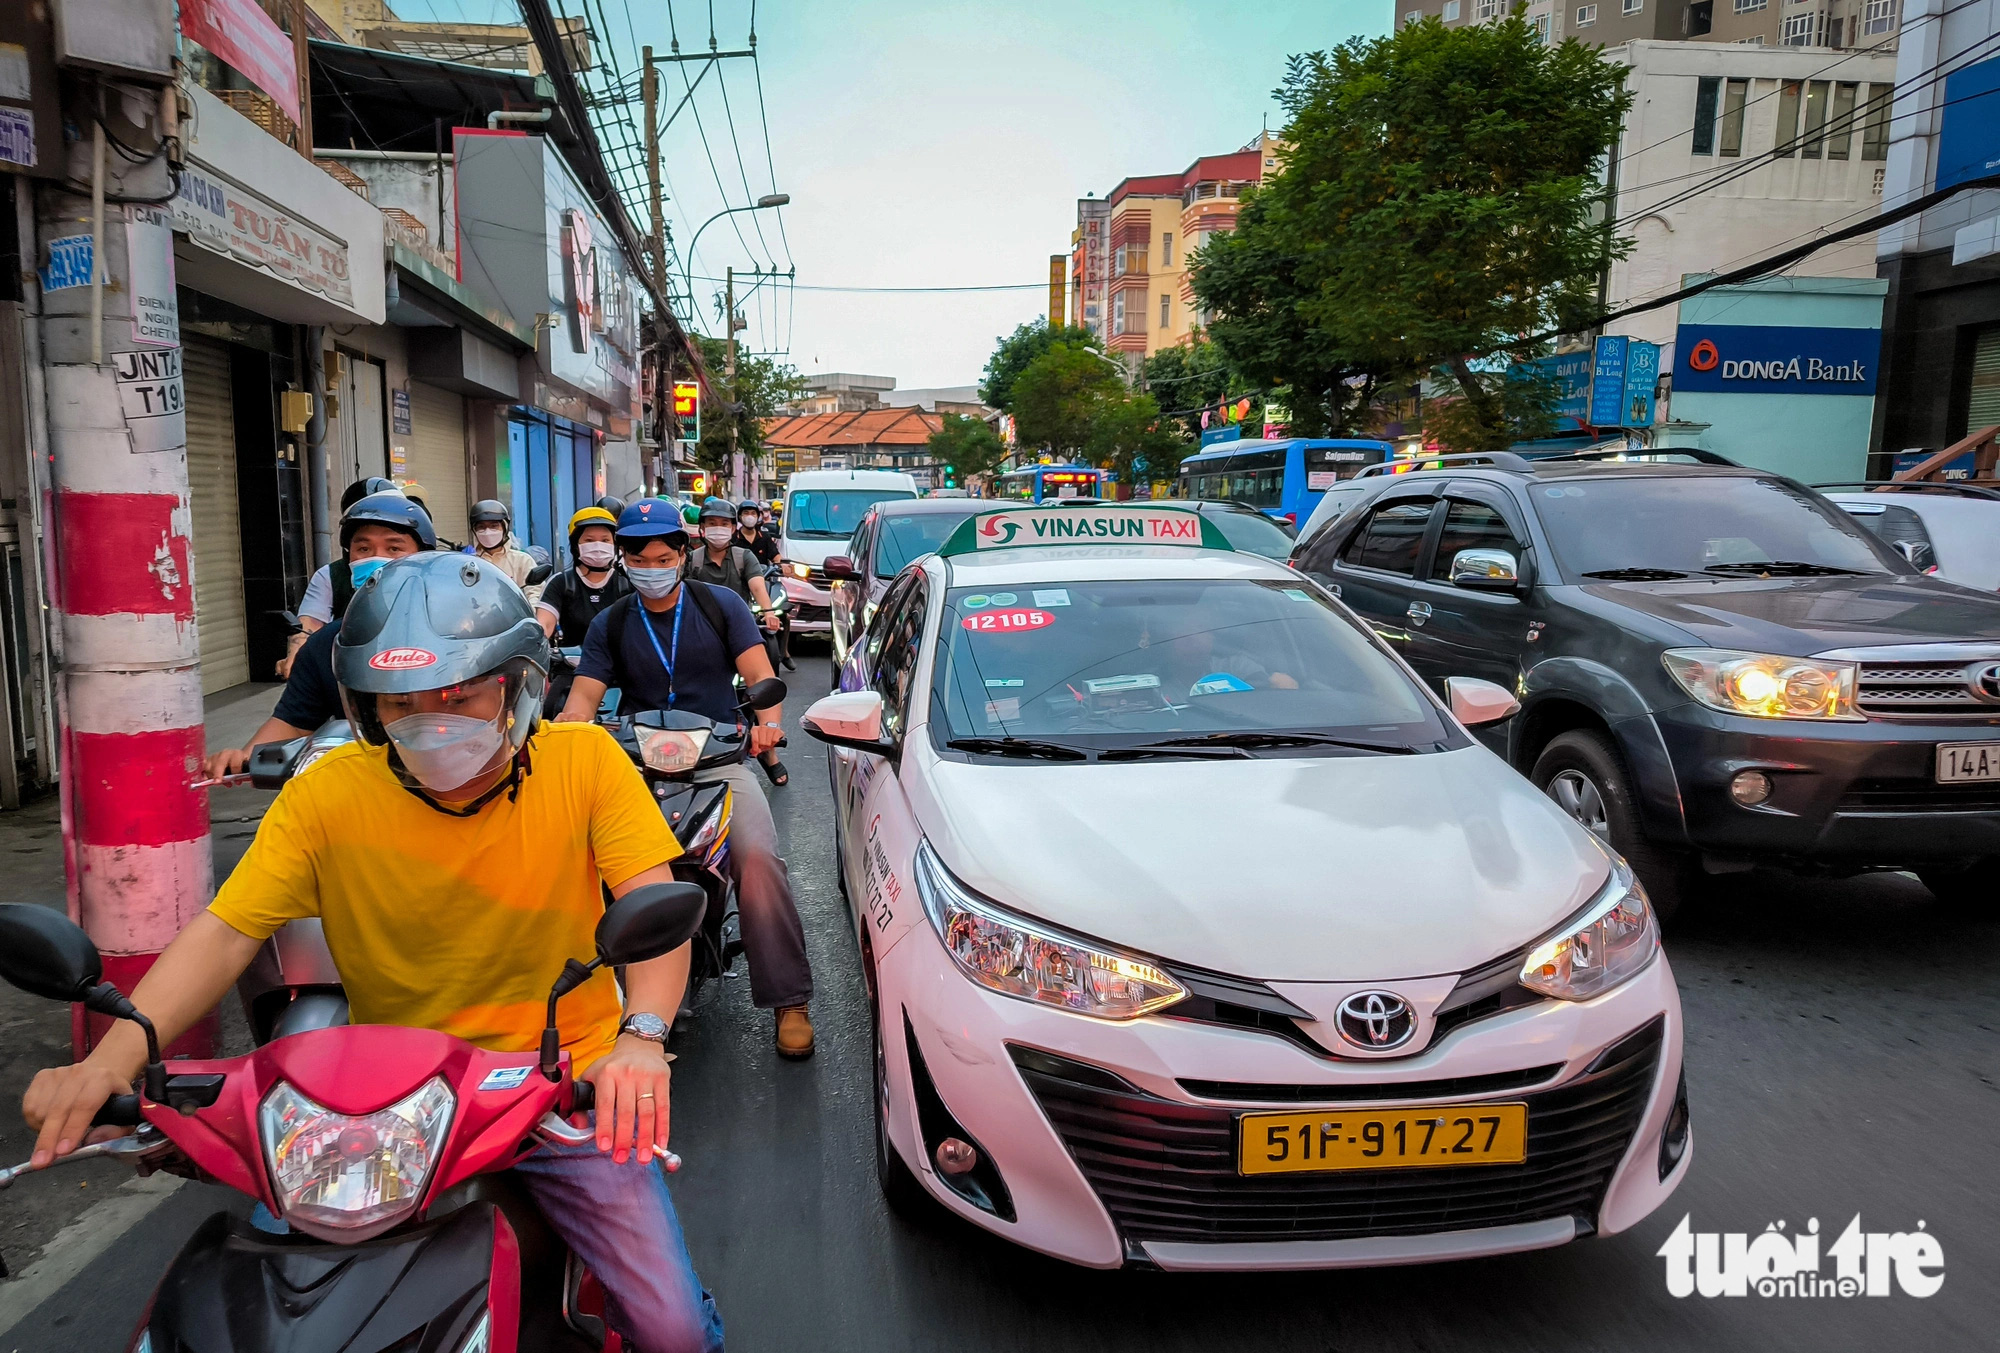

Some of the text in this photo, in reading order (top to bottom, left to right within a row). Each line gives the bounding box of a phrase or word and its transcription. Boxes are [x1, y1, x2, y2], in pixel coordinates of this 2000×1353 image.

[1088, 221, 1098, 300] HOTEL
[1806, 358, 1866, 382] Bank
[1325, 451, 1365, 462] SaigonBus
[1031, 518, 1197, 538] VINASUN TAXI
[968, 612, 1044, 630] 12105
[376, 650, 432, 664] Andes
[1948, 749, 2000, 778] 14A-
[885, 872, 902, 903] TAXI
[870, 886, 882, 914] 27
[876, 904, 893, 933] 27
[1267, 1116, 1501, 1162] 51F-917.27
